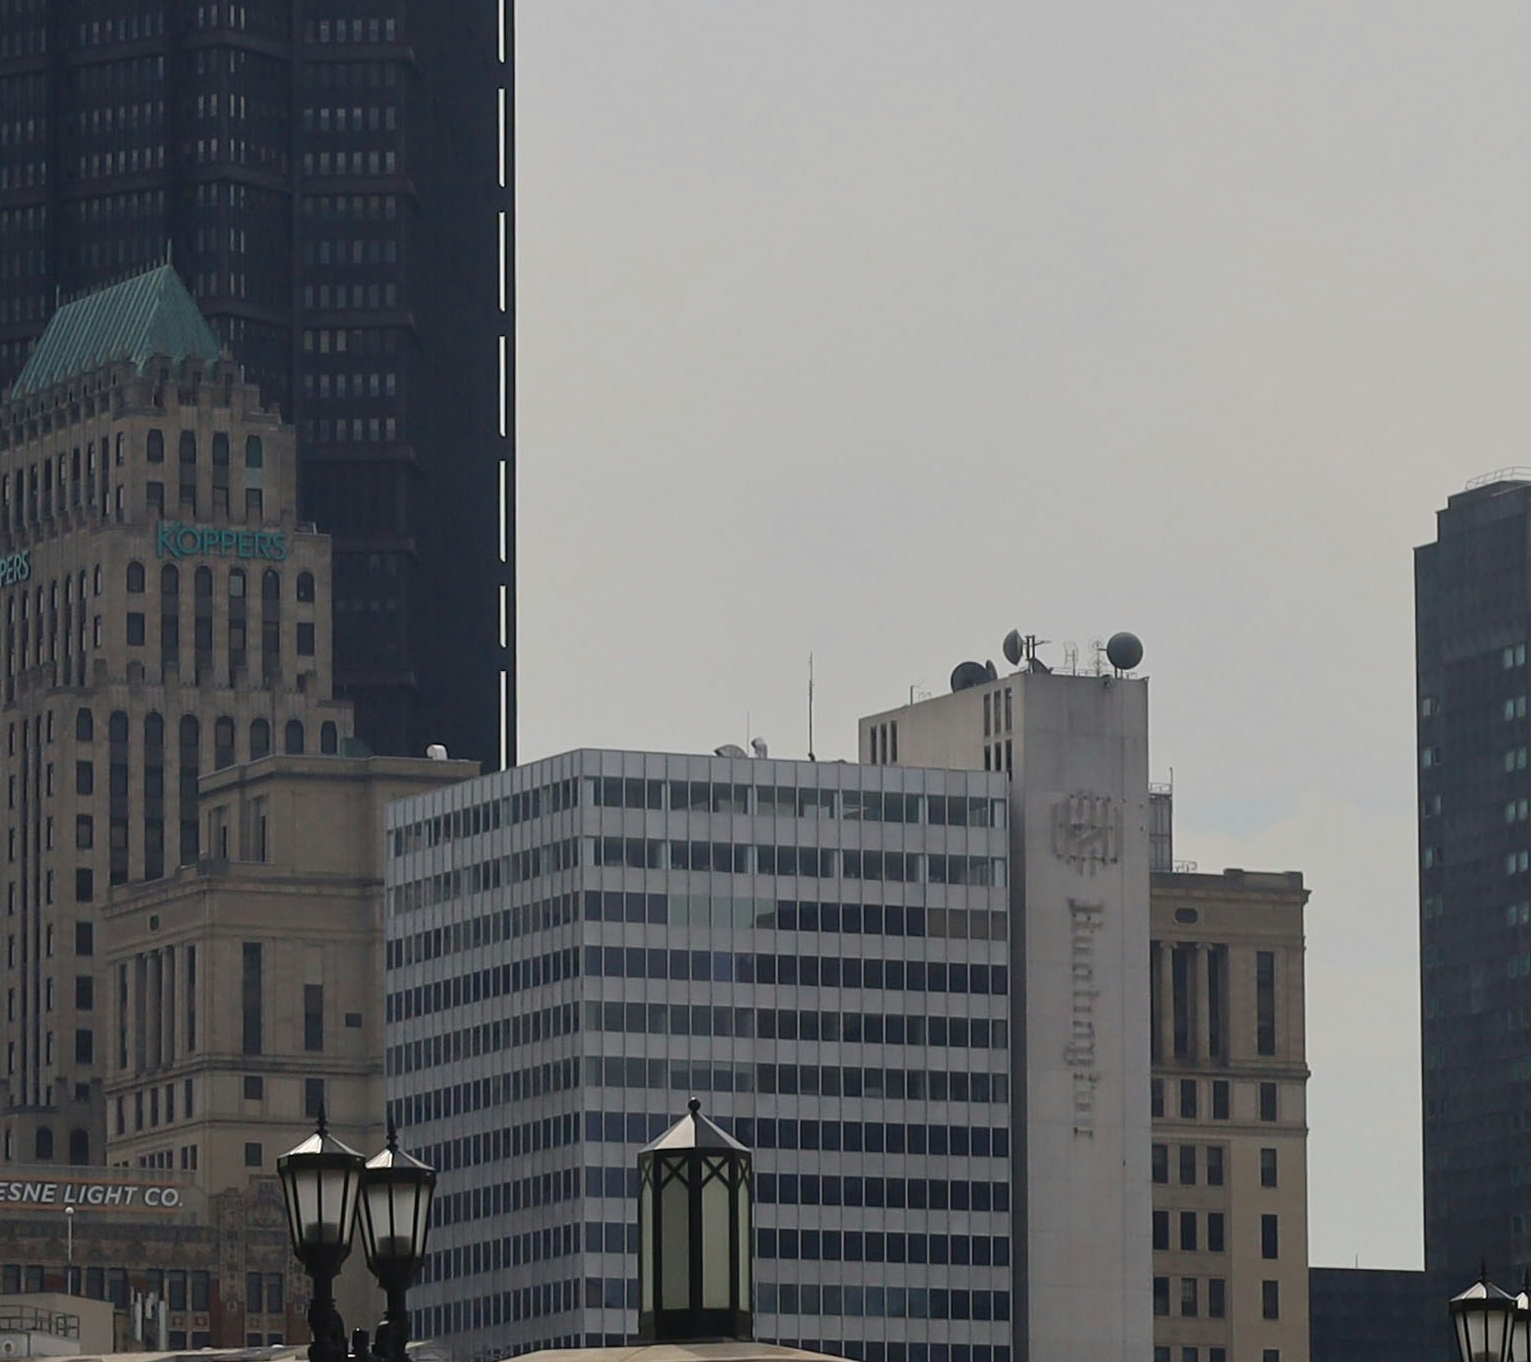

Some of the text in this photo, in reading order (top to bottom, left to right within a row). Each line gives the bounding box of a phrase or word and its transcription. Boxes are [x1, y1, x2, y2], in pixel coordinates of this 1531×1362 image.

[156, 519, 287, 560] KOPPERS
[63, 1184, 138, 1206] LIGHT
[144, 1188, 183, 1207] CO.
